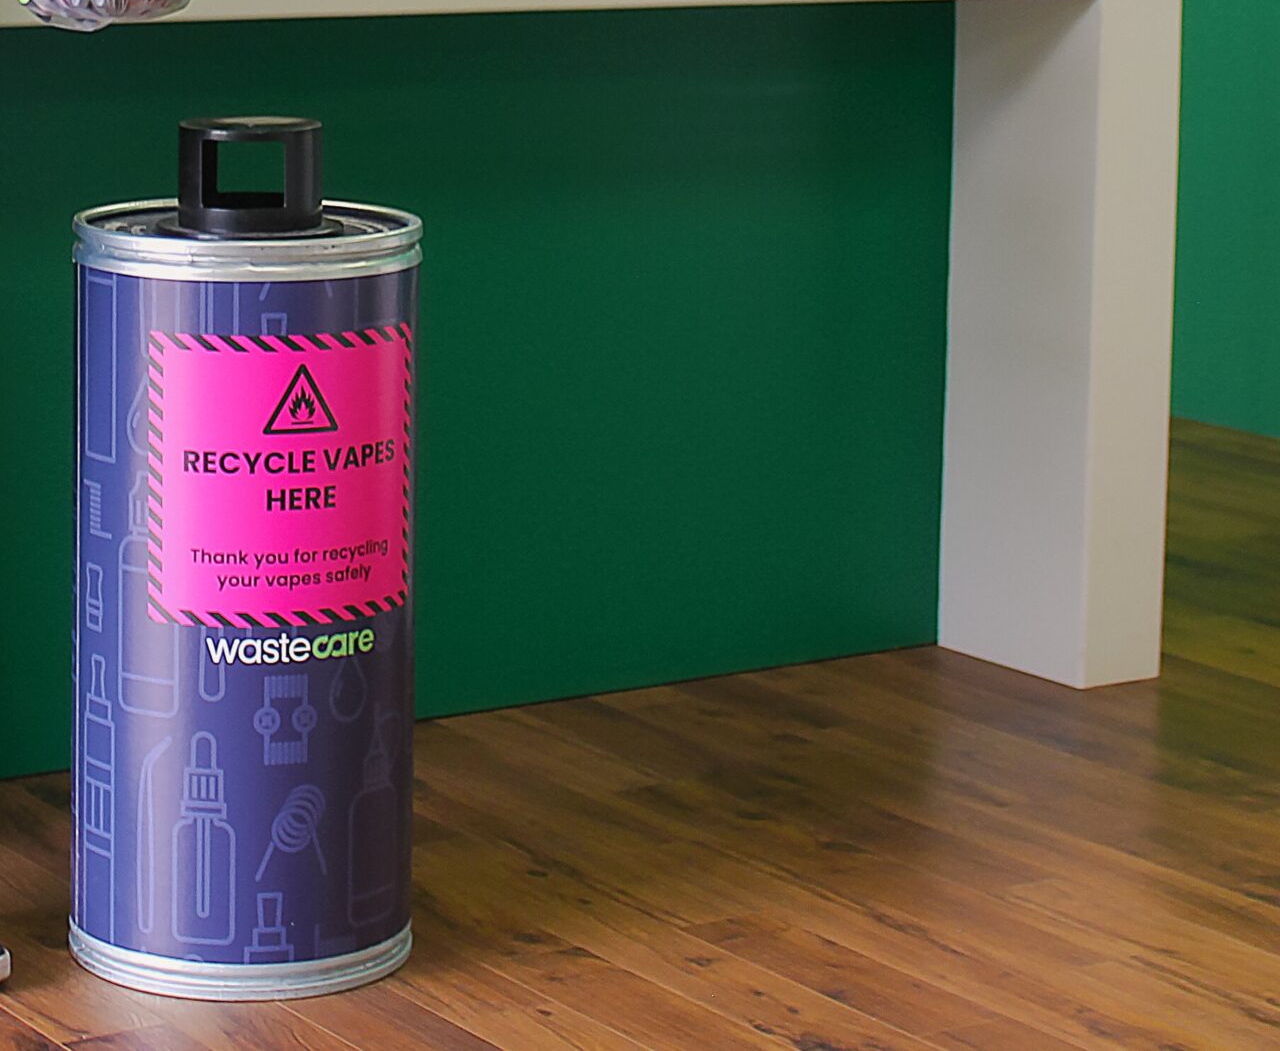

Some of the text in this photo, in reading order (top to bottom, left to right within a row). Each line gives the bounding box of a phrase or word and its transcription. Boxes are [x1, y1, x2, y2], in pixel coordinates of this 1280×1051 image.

[183, 439, 396, 475] RECYCLE VAPES
[266, 485, 337, 512] HERE
[190, 538, 388, 569] Thank you for recycling
[217, 563, 371, 592] your vapes safely
[205, 628, 375, 665] wastecare
